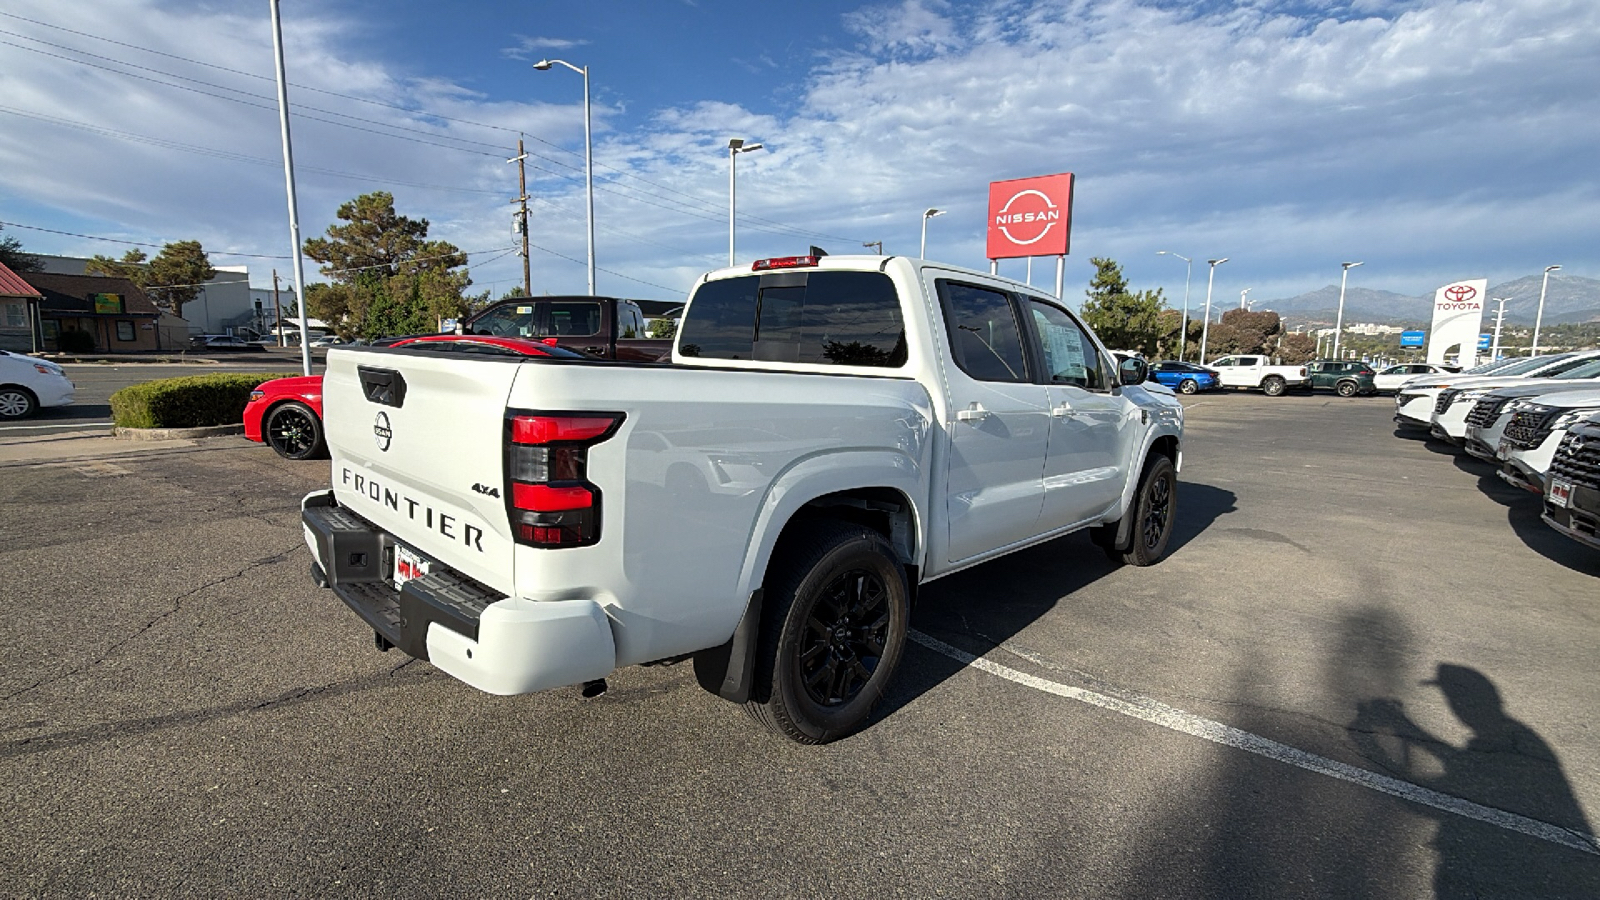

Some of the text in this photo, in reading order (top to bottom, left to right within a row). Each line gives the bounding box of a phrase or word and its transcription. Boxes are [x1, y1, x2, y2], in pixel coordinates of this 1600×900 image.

[996, 210, 1059, 225] NISSAN
[375, 426, 391, 438] SSAN
[342, 467, 484, 552] FRONTIER
